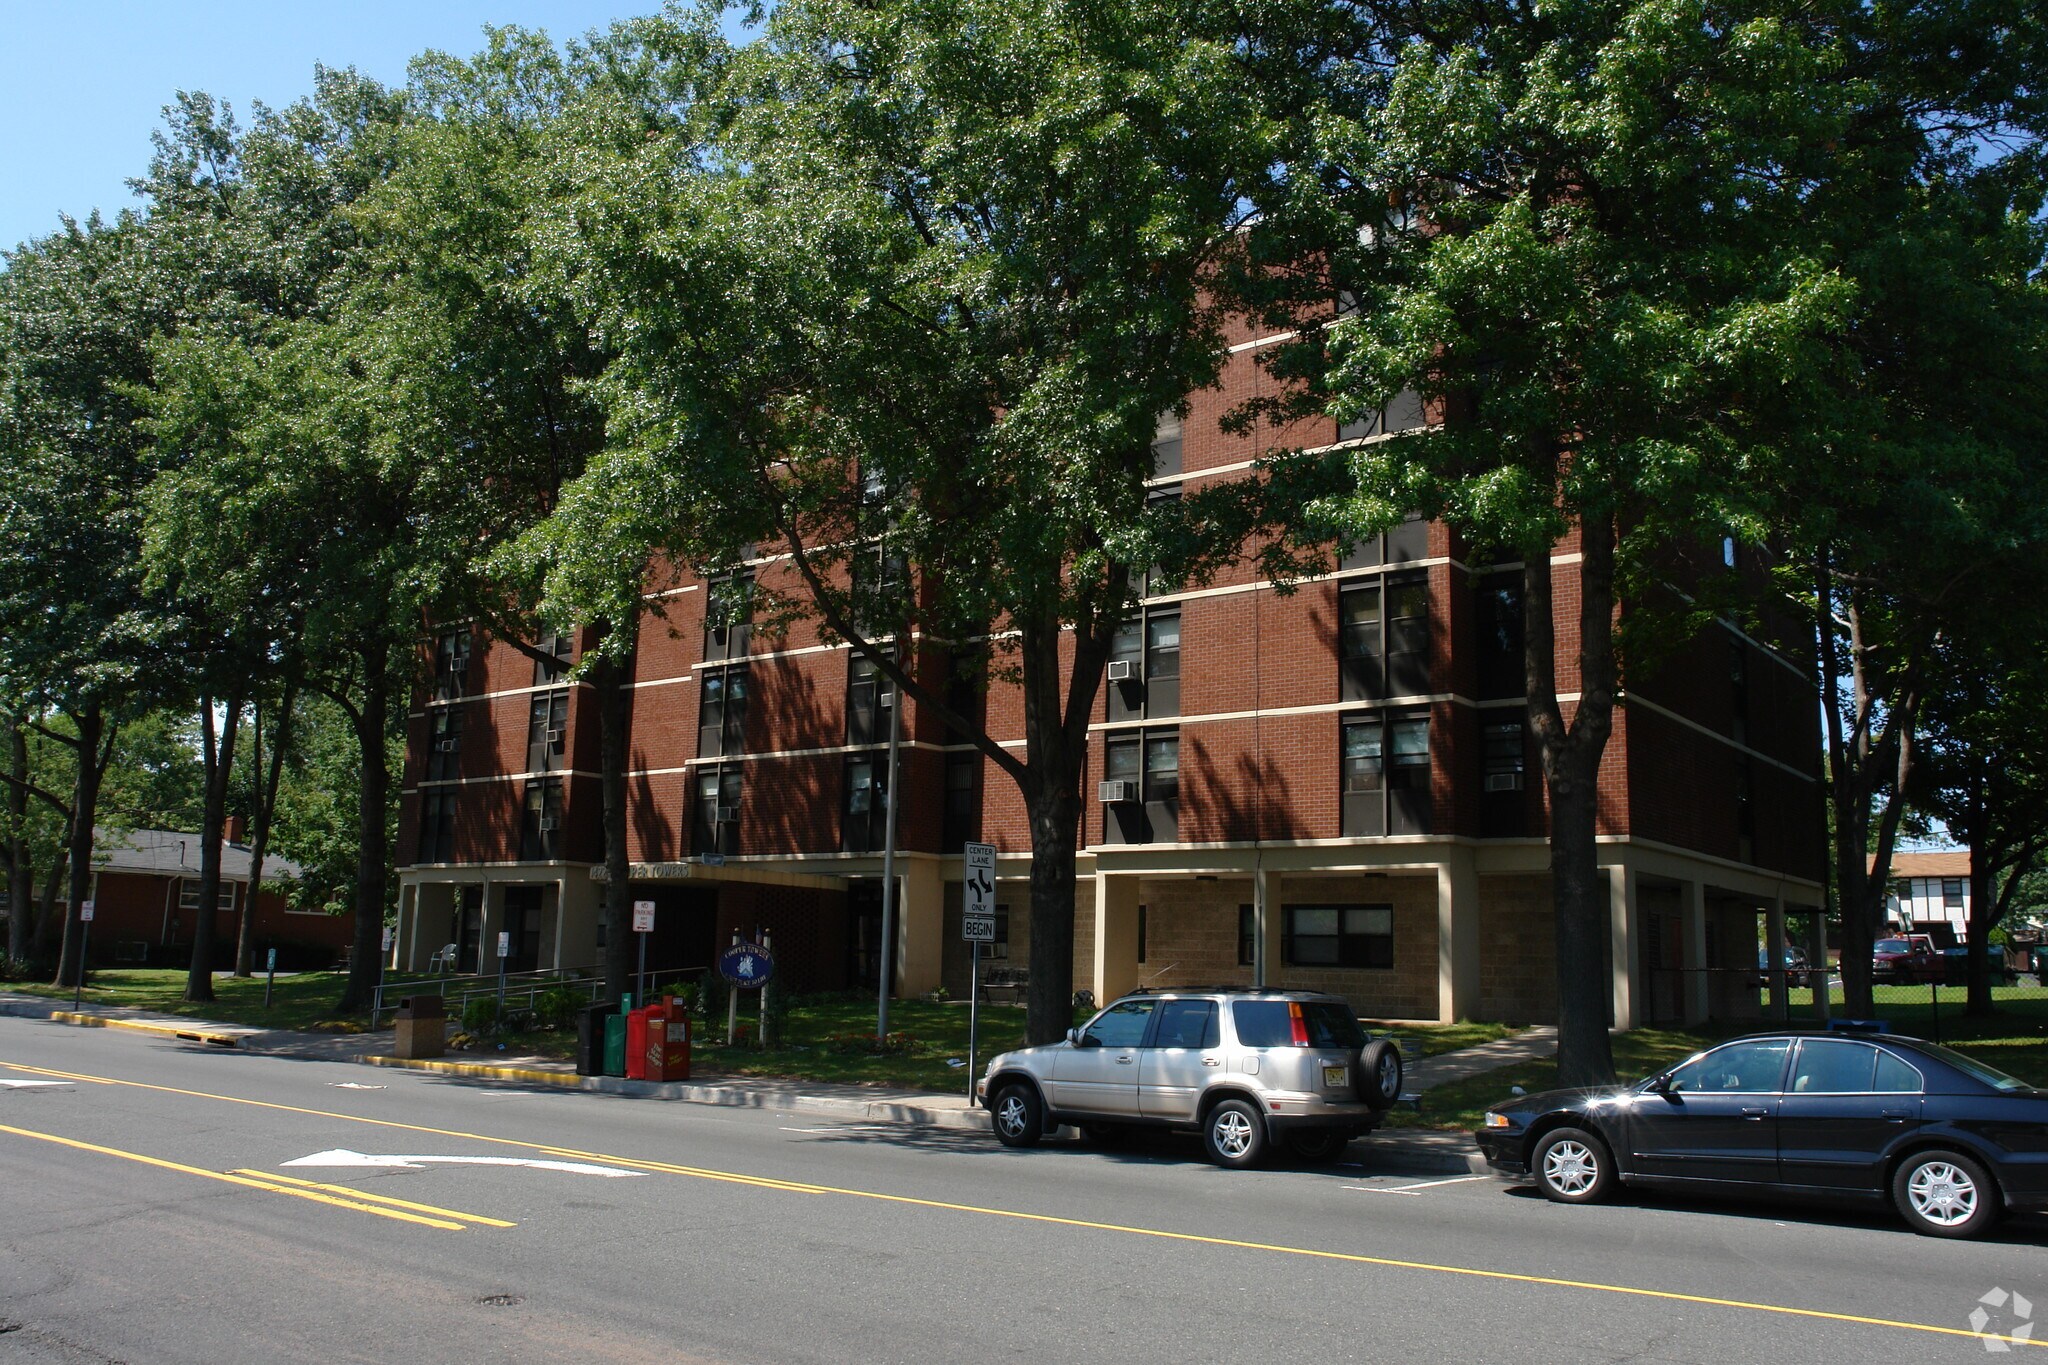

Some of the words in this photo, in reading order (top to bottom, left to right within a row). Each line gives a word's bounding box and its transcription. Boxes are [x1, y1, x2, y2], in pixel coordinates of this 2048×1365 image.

[969, 847, 993, 856] CENTER
[972, 856, 989, 865] LANE
[649, 864, 689, 879] TOWERS
[971, 904, 987, 912] ONLY
[966, 922, 993, 936] BEGIN
